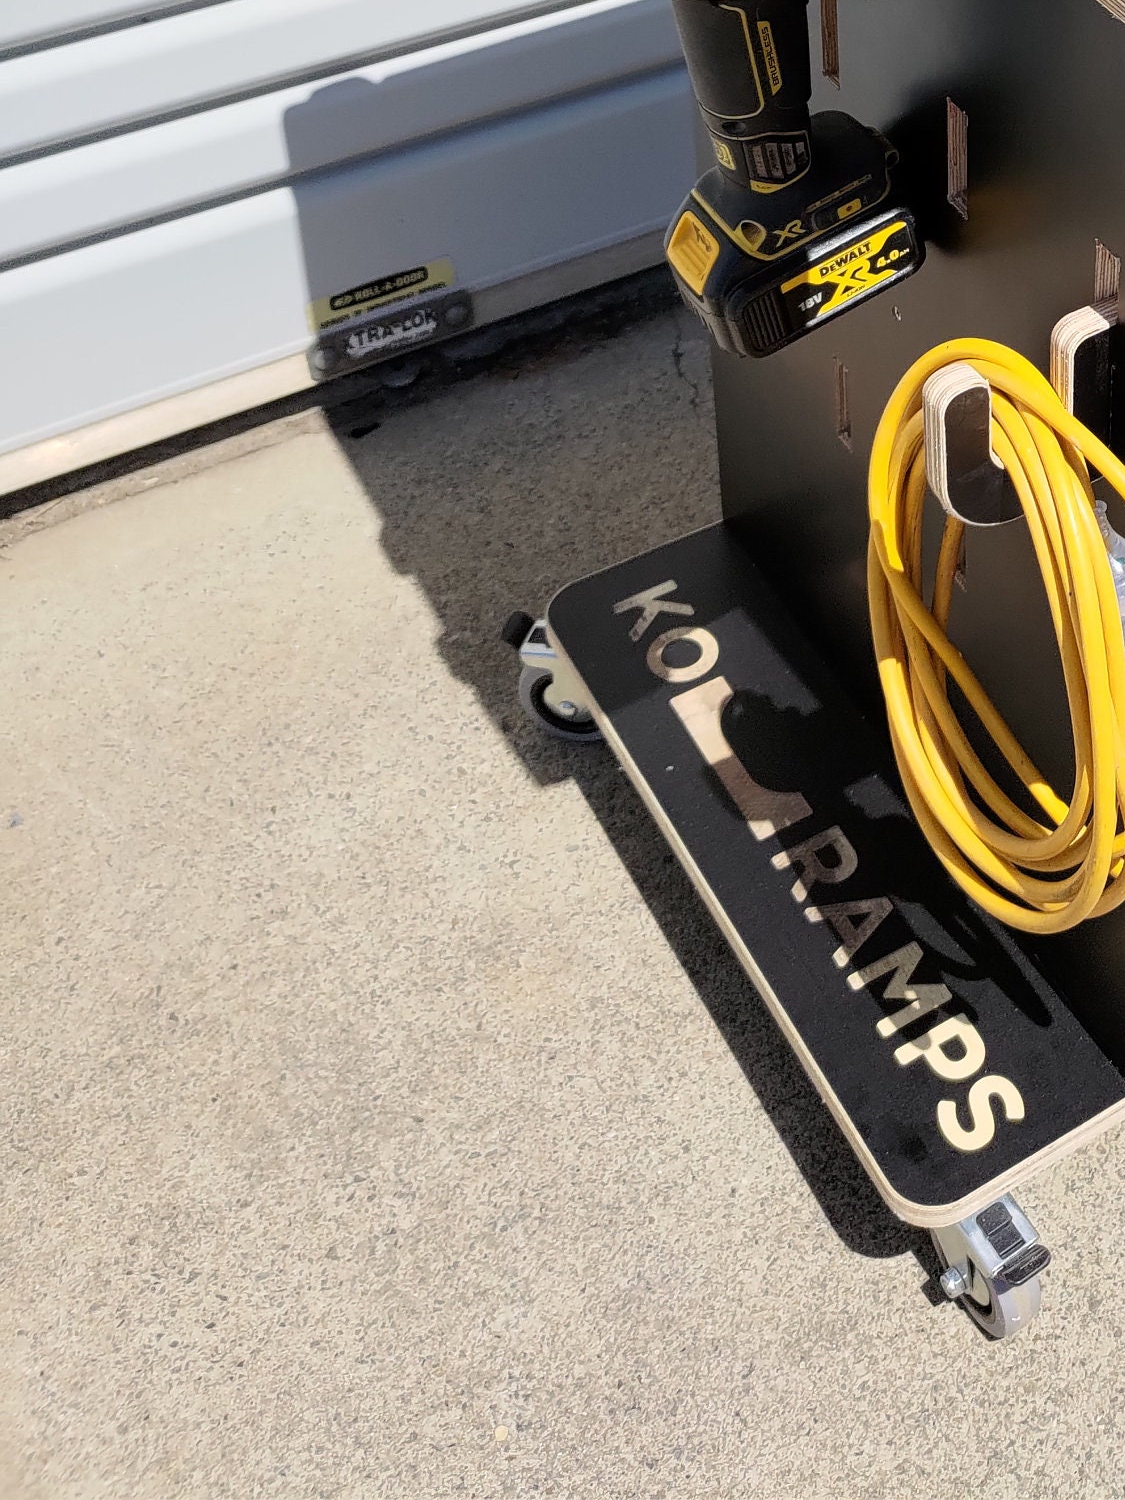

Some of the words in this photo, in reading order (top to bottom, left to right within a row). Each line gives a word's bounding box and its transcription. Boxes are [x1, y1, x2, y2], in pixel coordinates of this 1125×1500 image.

[761, 25, 780, 87] BRUSHLESS
[819, 241, 872, 278] DEWALT
[798, 291, 823, 312] 18V
[612, 578, 720, 685] KO
[770, 824, 1026, 1154] RAMPS
